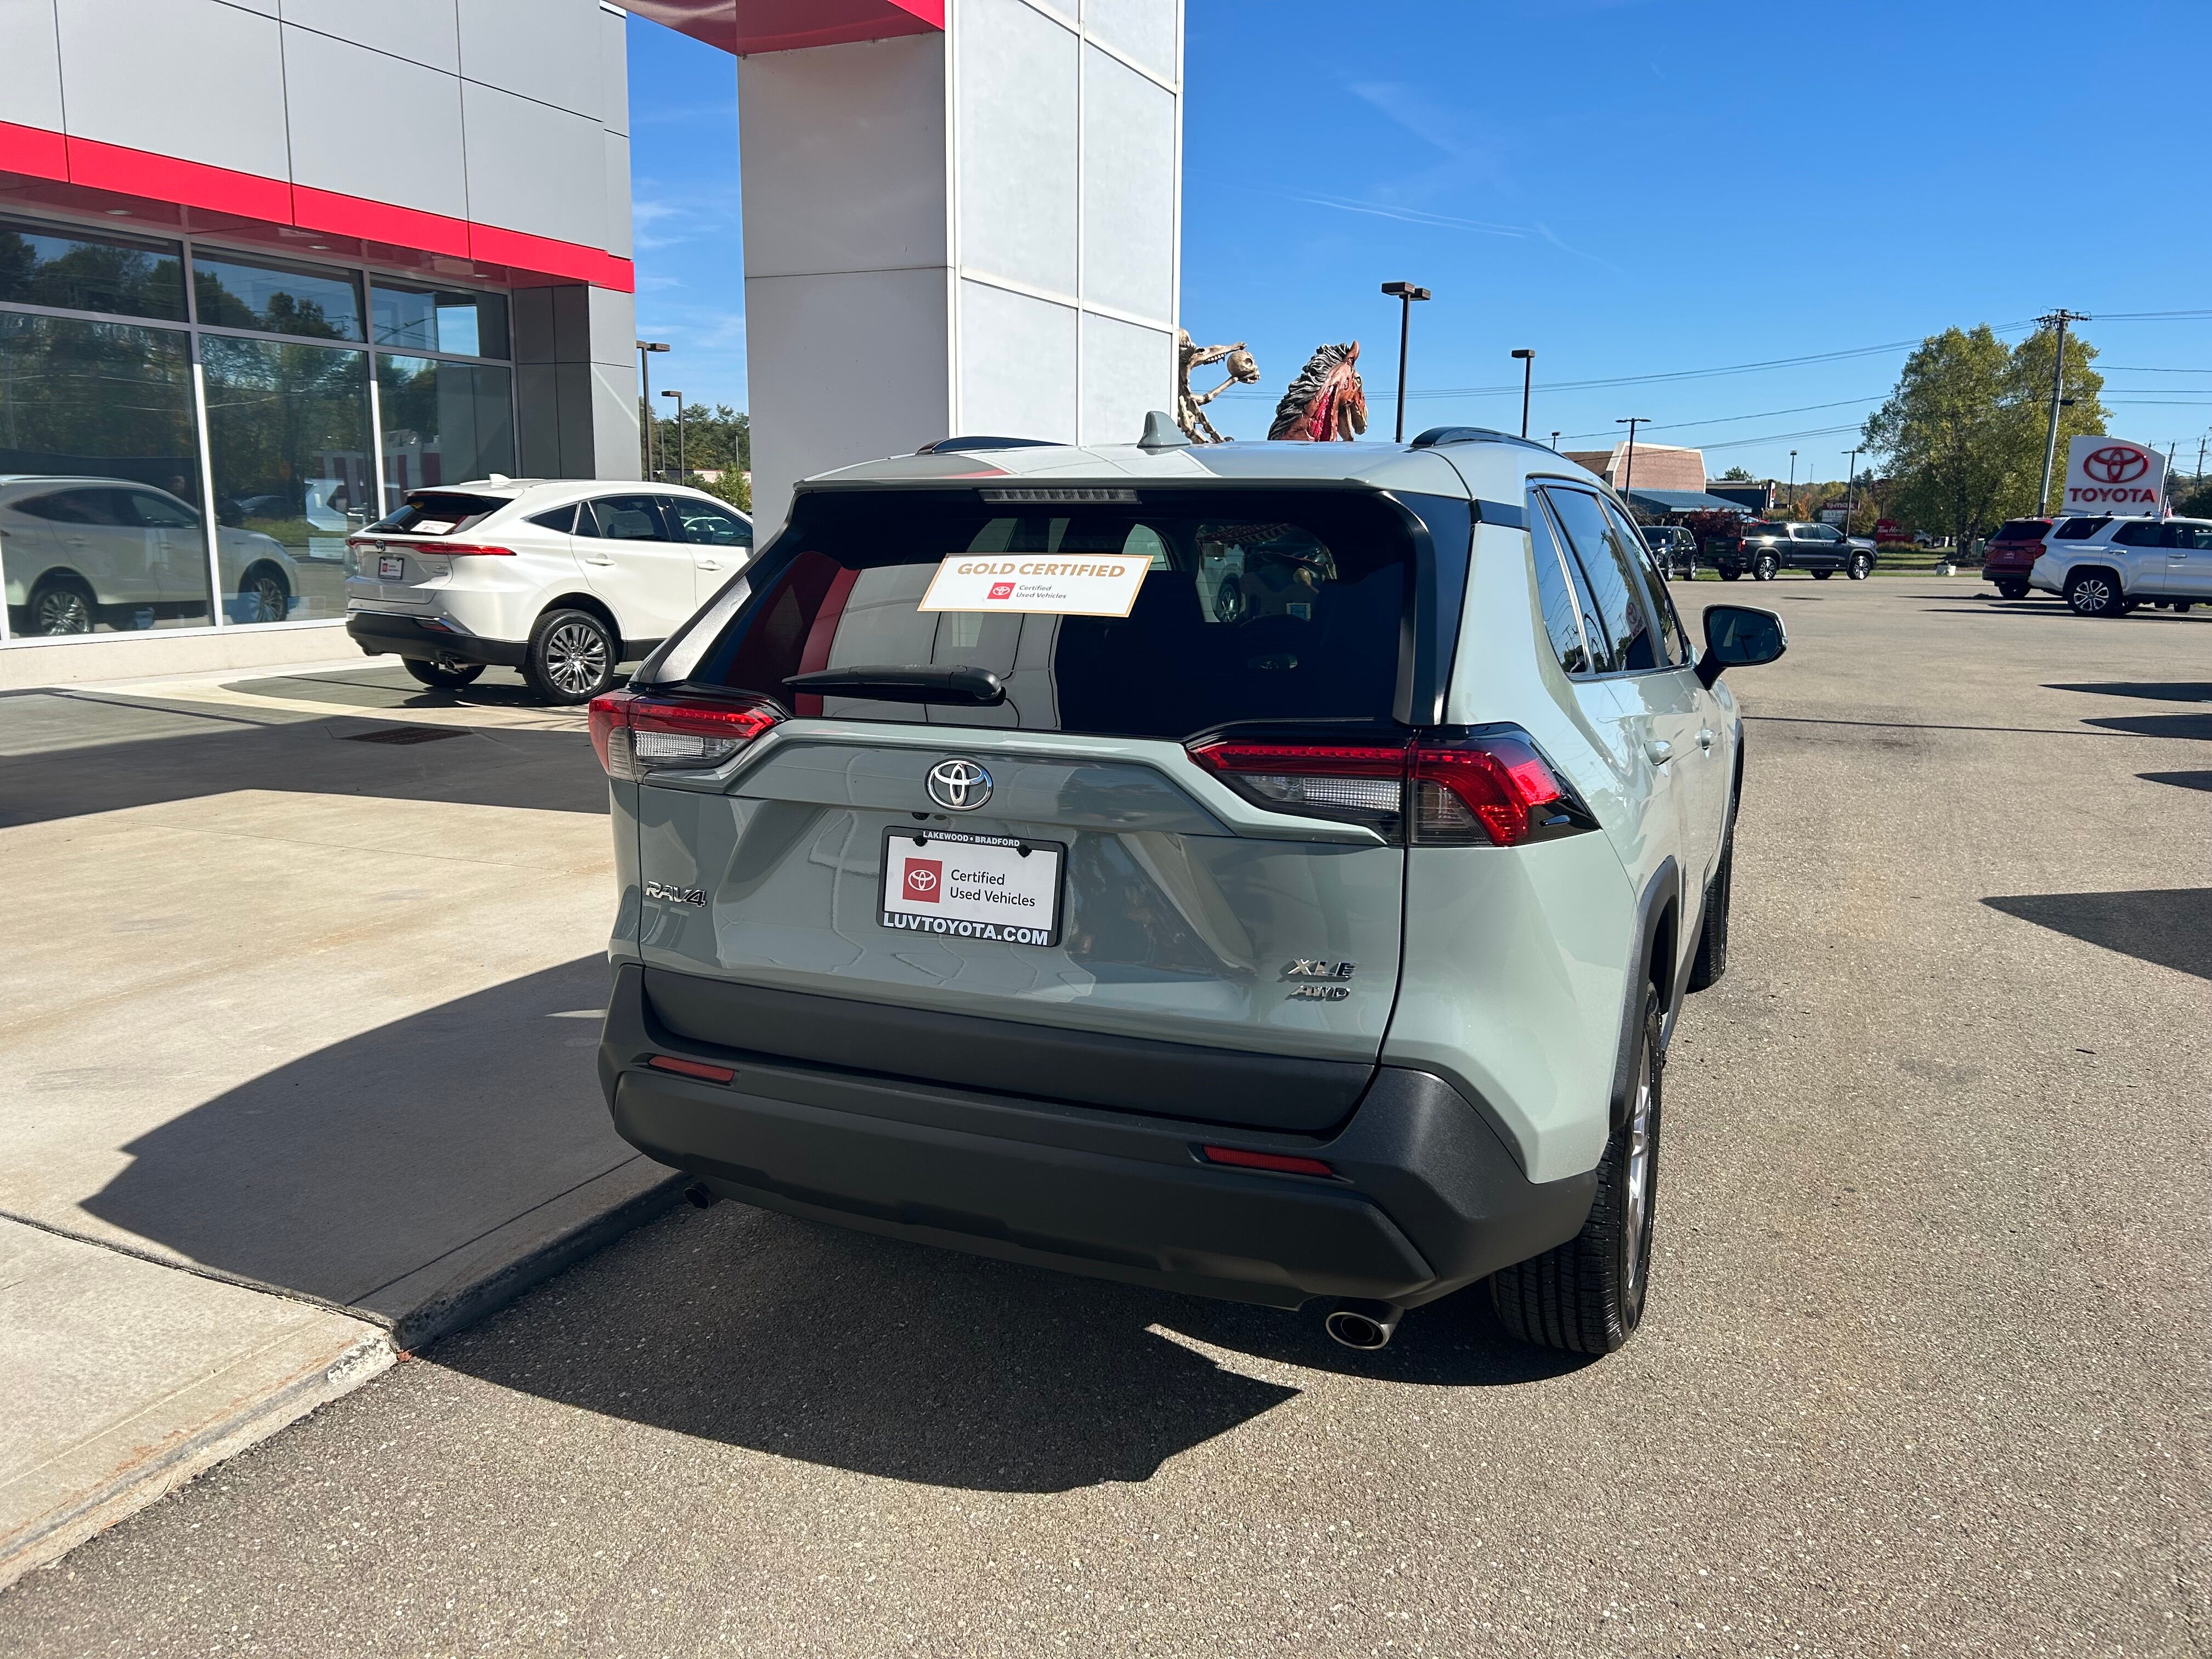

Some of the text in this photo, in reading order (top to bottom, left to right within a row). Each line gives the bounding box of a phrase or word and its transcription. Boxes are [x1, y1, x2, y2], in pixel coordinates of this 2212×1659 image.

[2069, 488, 2156, 503] TOYOTA
[957, 563, 1125, 577] GOLD CERTIFIED
[923, 831, 1020, 847] LAKEWOOD BRADFORD
[951, 869, 1005, 885] Certified
[646, 880, 707, 907] RAV4
[950, 887, 1036, 906] Used Vehicles
[883, 912, 1048, 946] LUVTOYOTA.COM
[1288, 959, 1358, 977] XLE
[1290, 985, 1351, 997] AWD
